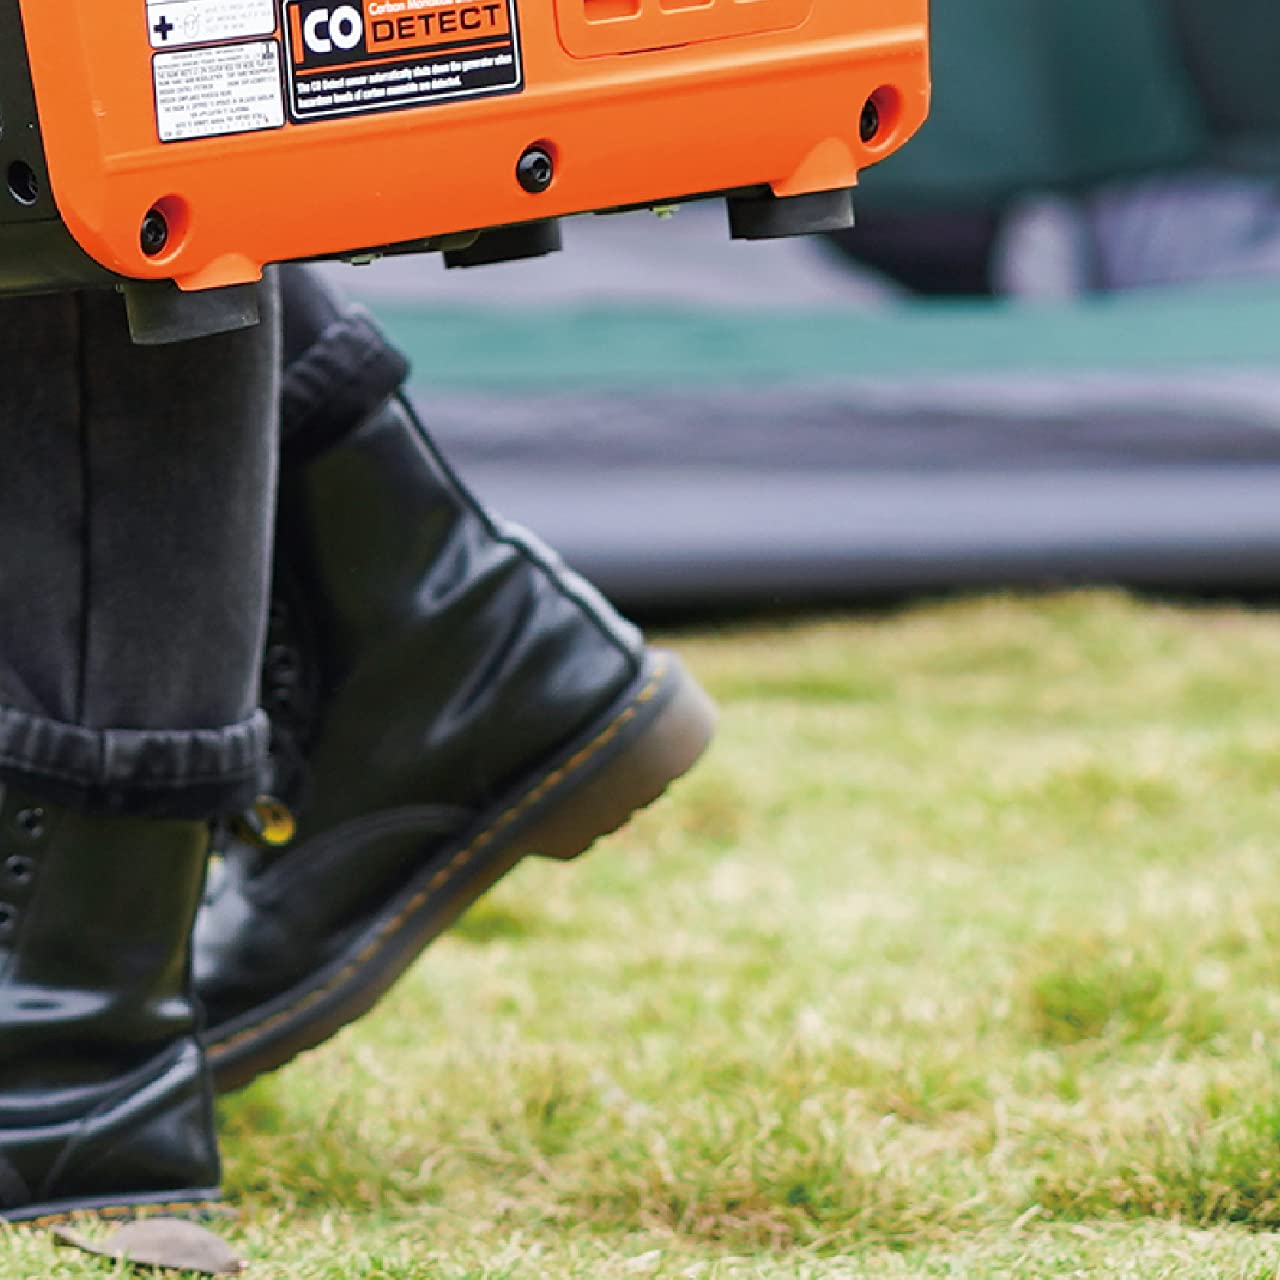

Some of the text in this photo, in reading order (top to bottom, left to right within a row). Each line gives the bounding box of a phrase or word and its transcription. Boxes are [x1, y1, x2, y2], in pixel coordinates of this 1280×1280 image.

[369, 1, 406, 16] Carbon
[372, 4, 500, 42] DETECT
[304, 5, 363, 53] CO
